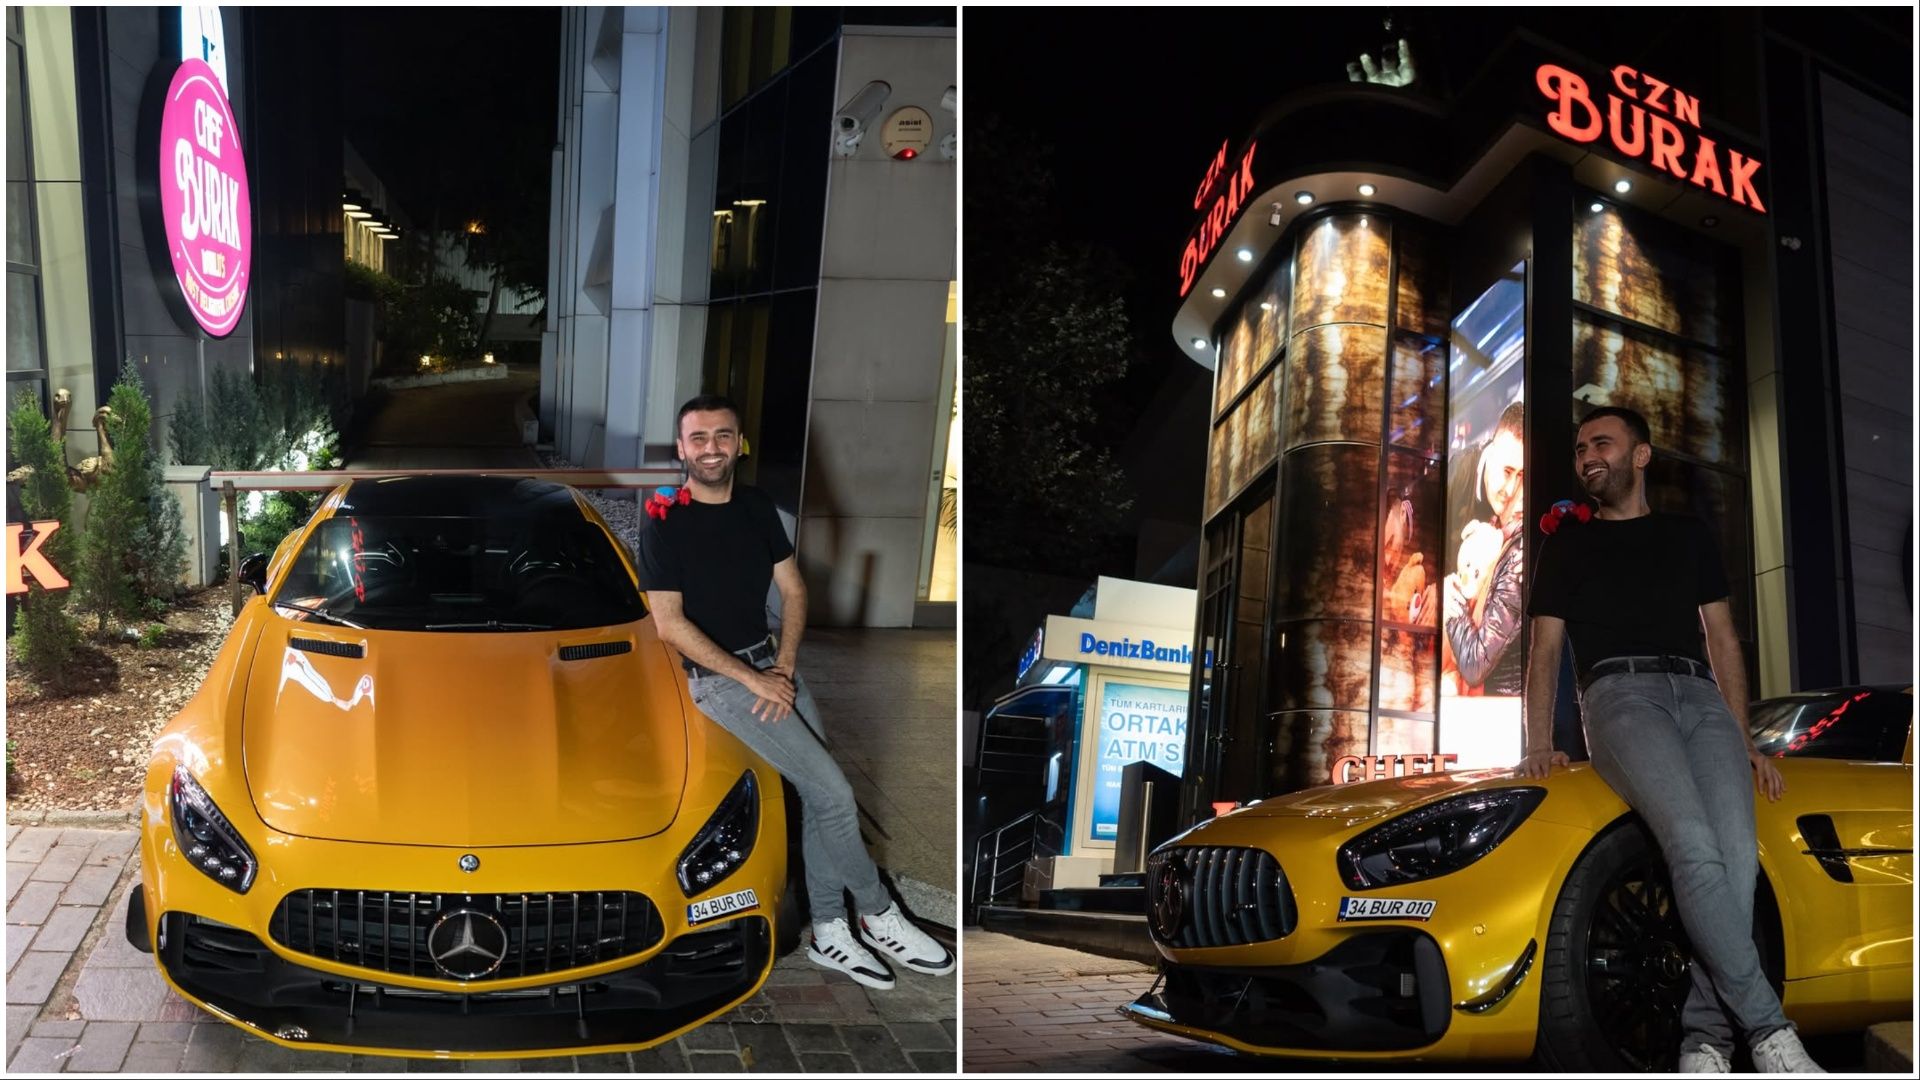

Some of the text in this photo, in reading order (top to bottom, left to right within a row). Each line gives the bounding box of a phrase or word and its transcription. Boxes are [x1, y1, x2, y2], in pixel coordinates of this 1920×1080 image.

[1611, 64, 1701, 128] CZN
[194, 98, 223, 160] CHEF
[1535, 63, 1767, 214] BURAK
[175, 137, 242, 251] BURAK
[1194, 138, 1229, 210] CZN
[1180, 141, 1257, 297] BURAK
[1080, 632, 1194, 664] DenizBank
[1108, 712, 1187, 736] ORTAK
[693, 890, 756, 919] 34 BUR 010
[1349, 900, 1433, 915] 34 BUR 010
